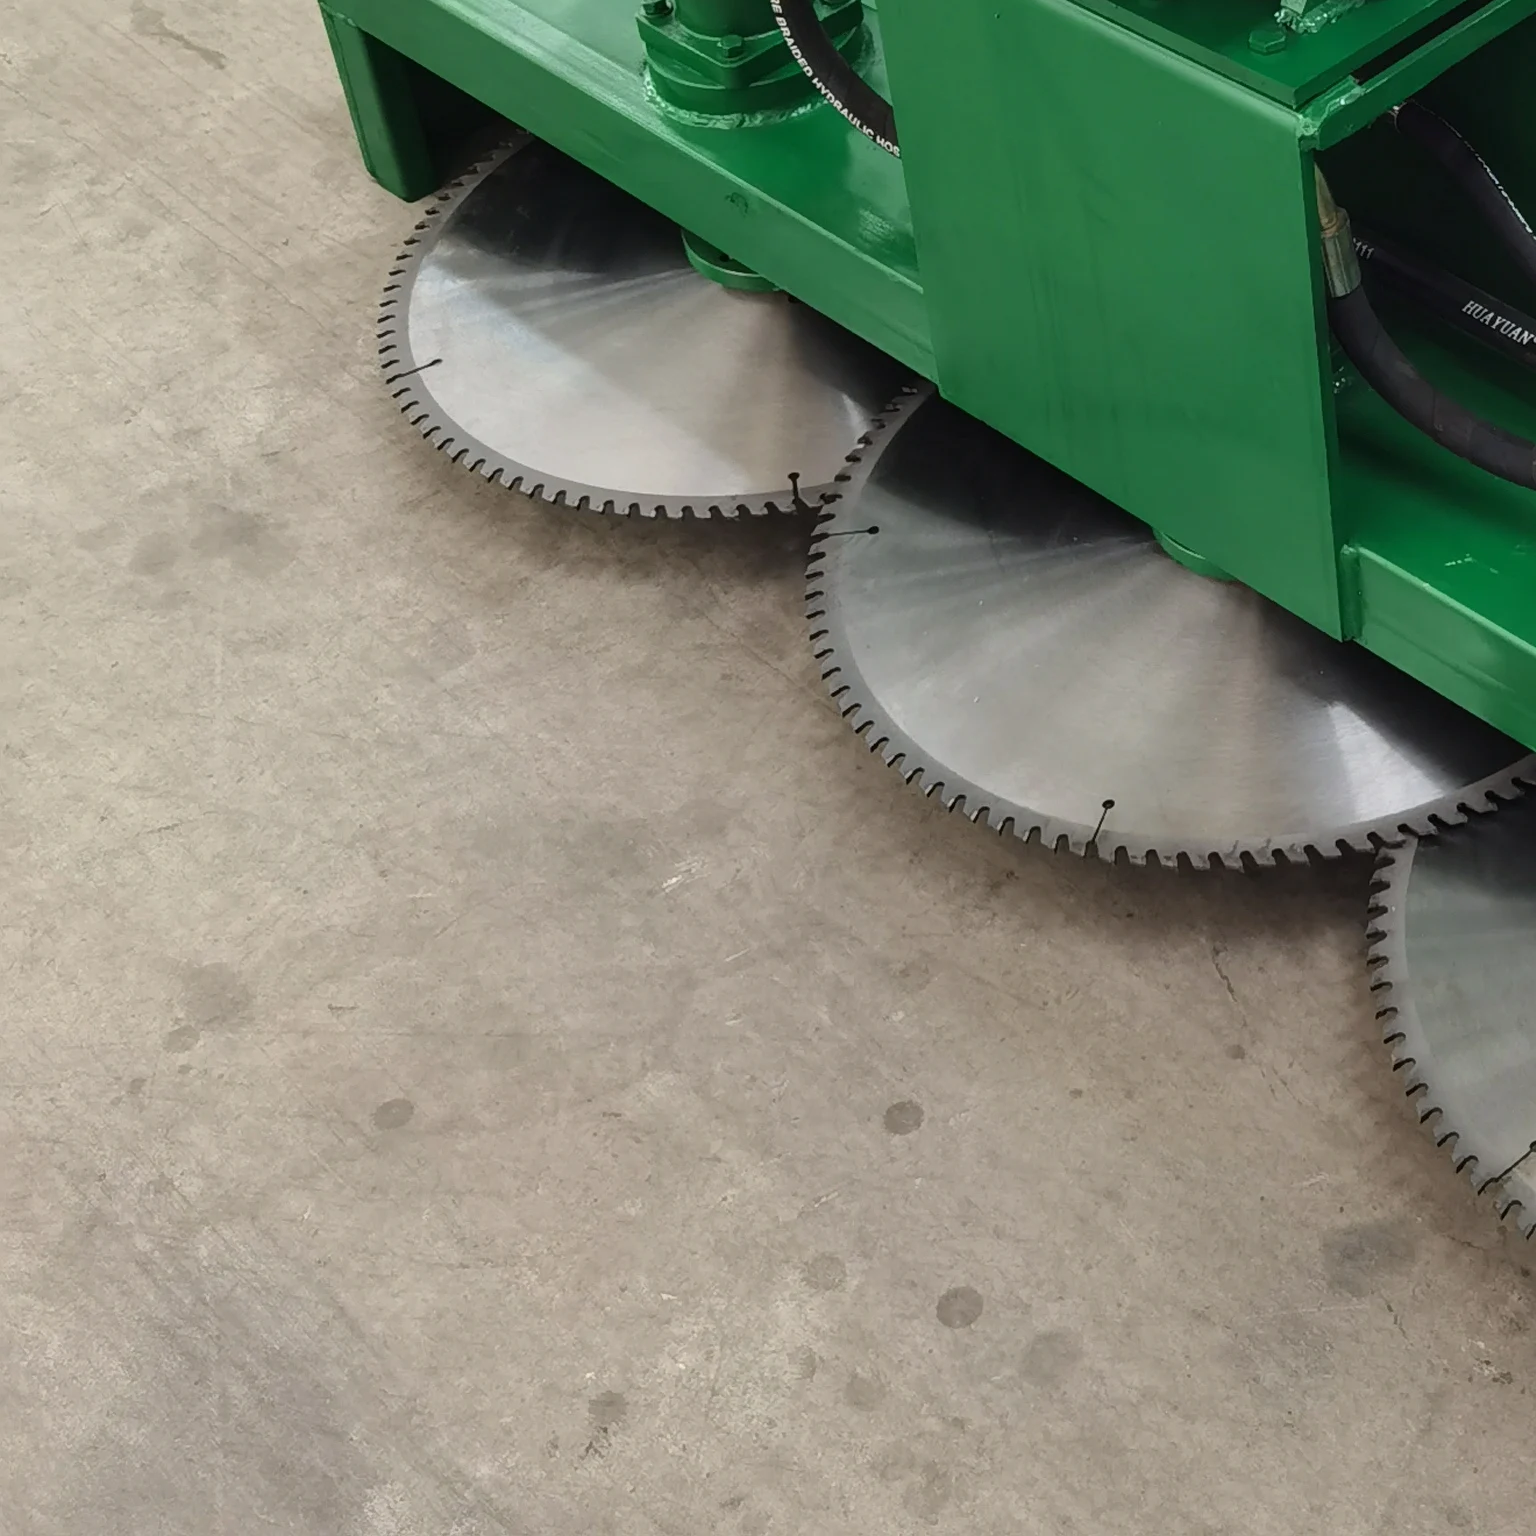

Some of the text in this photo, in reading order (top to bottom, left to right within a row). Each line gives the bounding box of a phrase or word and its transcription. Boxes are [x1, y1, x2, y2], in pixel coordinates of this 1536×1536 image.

[776, 15, 813, 82] BRAIDED
[812, 76, 874, 140] HYDRAULIC
[875, 133, 901, 158] HOS
